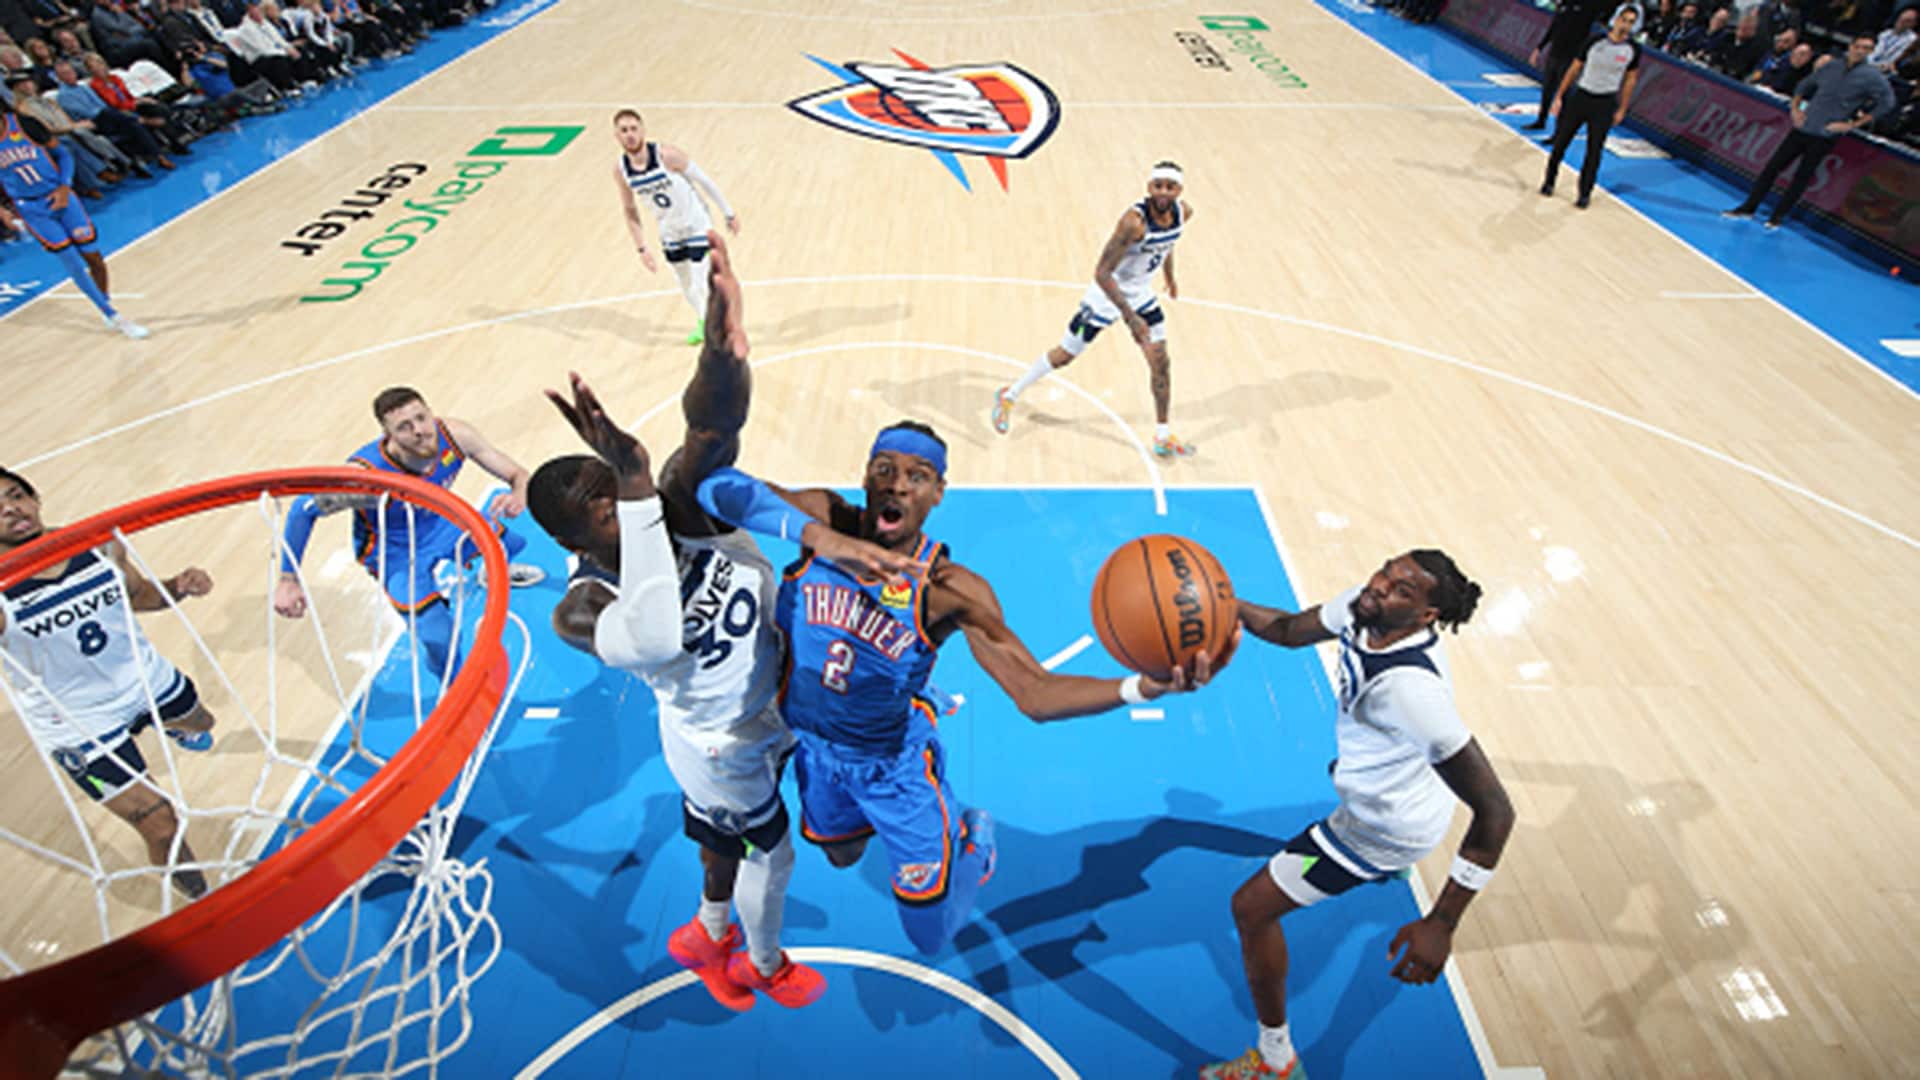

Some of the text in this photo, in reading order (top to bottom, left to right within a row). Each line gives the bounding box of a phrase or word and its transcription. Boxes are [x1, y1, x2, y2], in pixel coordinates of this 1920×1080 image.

[14, 164, 42, 186] 11
[1690, 102, 1844, 193] BRAUS
[281, 162, 427, 256] center
[299, 160, 508, 303] paycom
[653, 193, 671, 208] 0
[682, 587, 757, 670] 30
[683, 557, 735, 632] OLVES
[1166, 548, 1205, 649] Wilson
[77, 620, 108, 656] 8
[821, 639, 856, 696] 2
